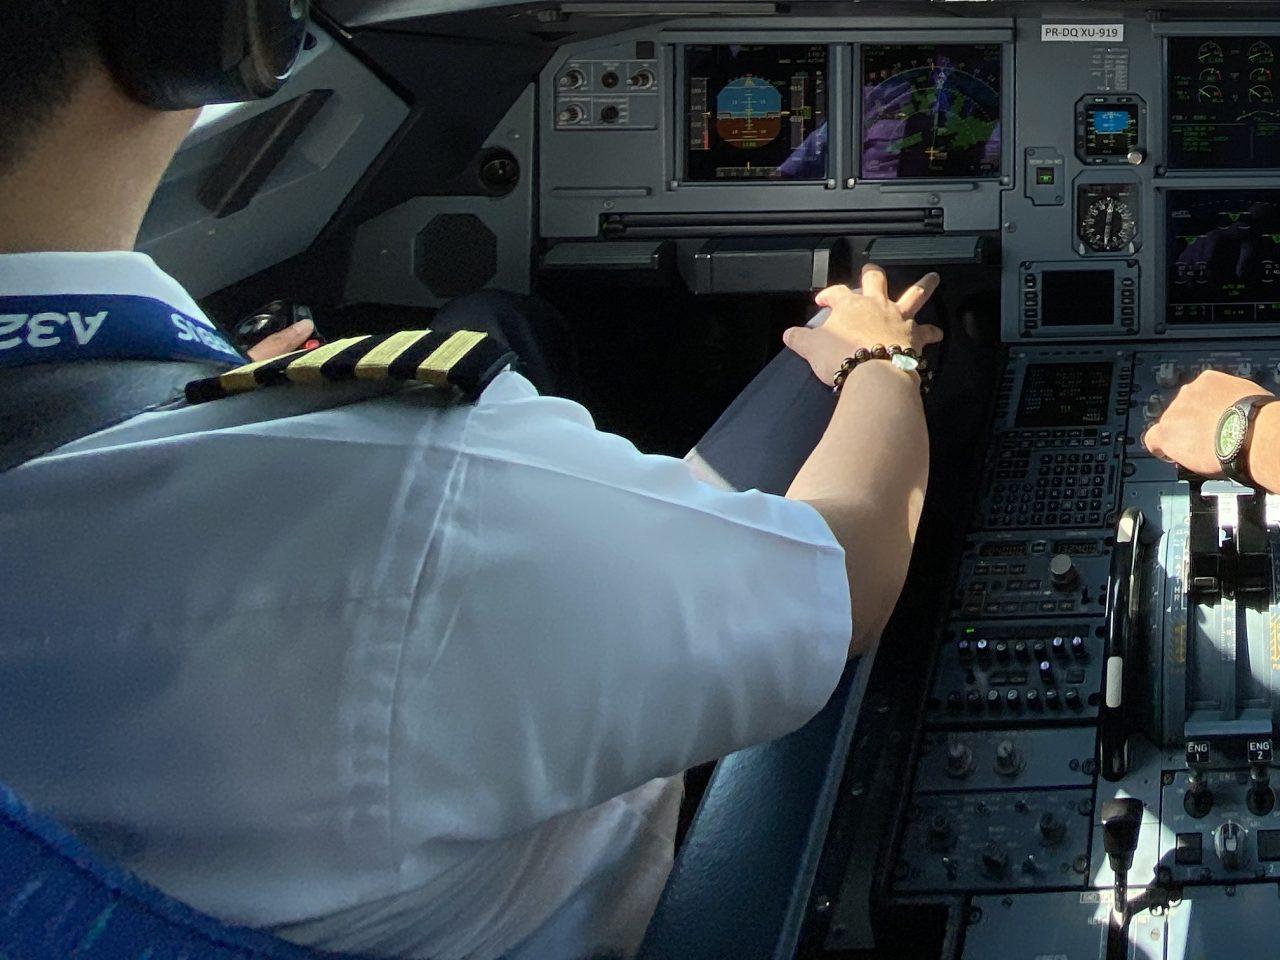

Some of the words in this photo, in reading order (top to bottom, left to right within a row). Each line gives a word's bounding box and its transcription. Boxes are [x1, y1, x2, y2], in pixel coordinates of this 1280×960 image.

[1045, 27, 1079, 38] PR-DQ
[1081, 27, 1118, 38] XU-919
[1187, 743, 1208, 754] ENG
[1250, 742, 1270, 752] ENG
[1257, 751, 1264, 760] 2
